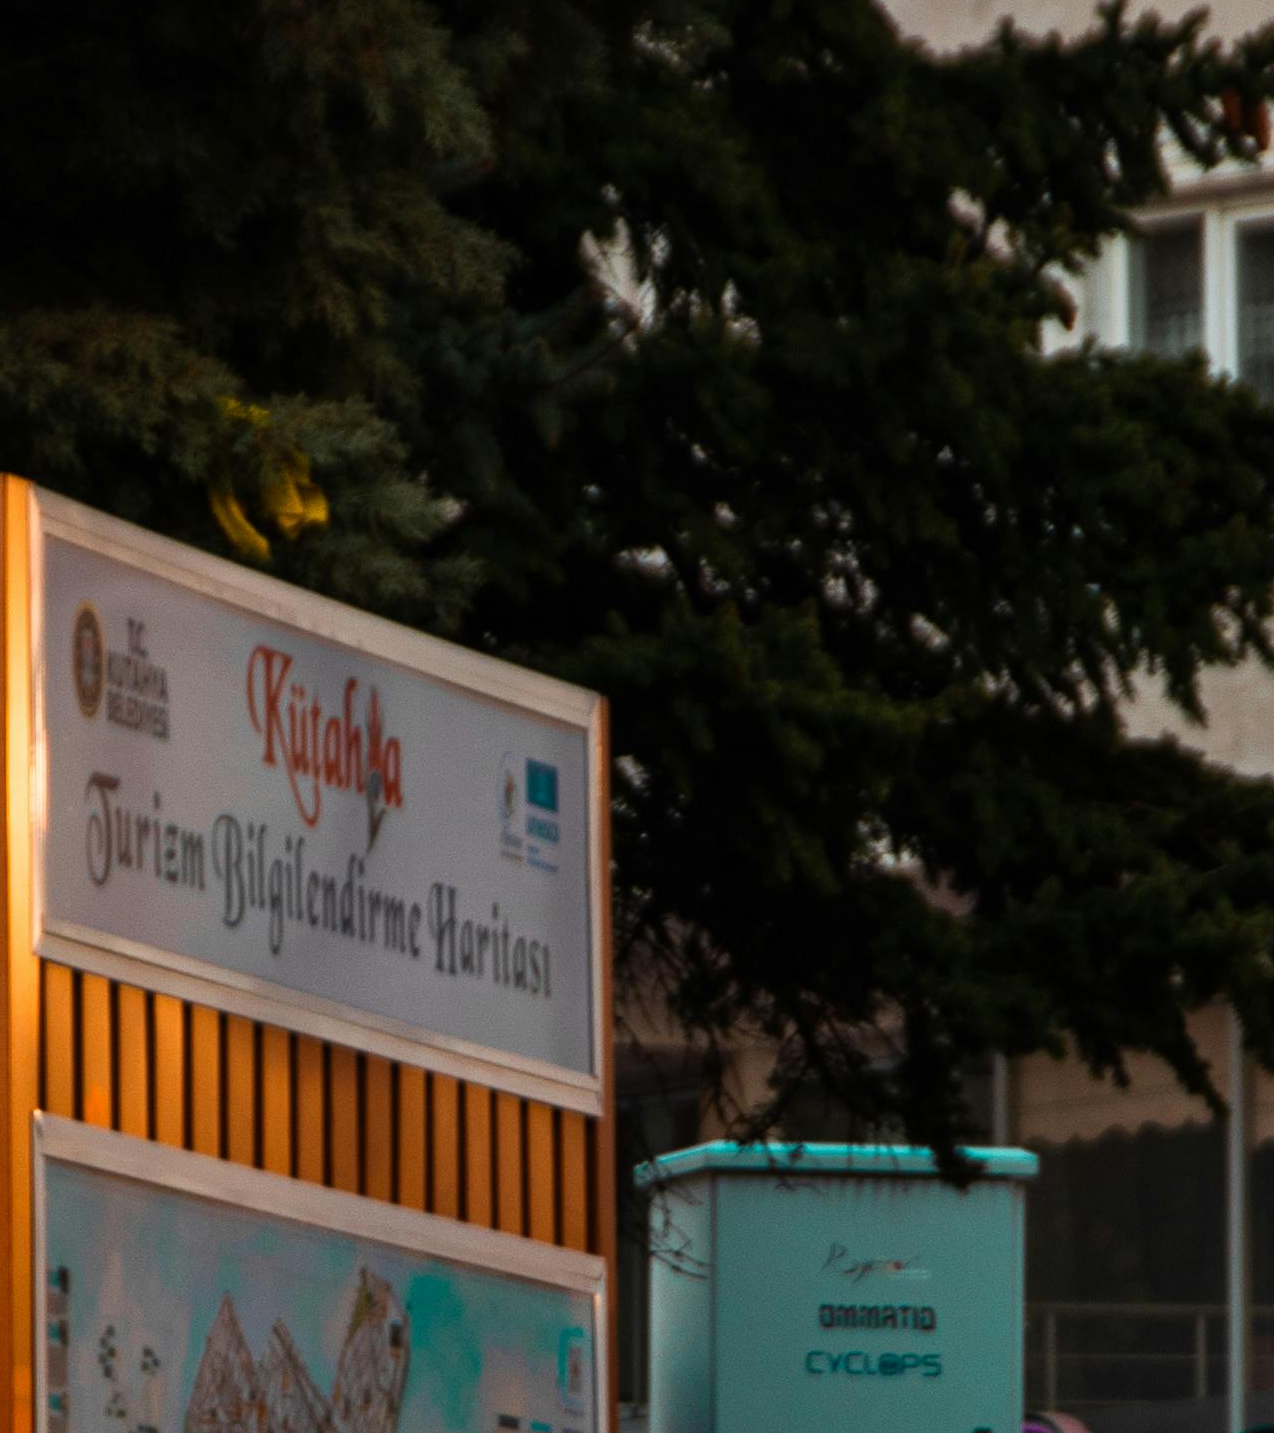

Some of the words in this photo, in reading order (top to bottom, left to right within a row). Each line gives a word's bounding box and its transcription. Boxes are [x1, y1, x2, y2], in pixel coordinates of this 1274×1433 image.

[84, 771, 207, 891] Turizm
[211, 813, 422, 958] Bilgilendirme
[428, 882, 552, 999] Haritası
[805, 1350, 943, 1377] CYCLOPS
